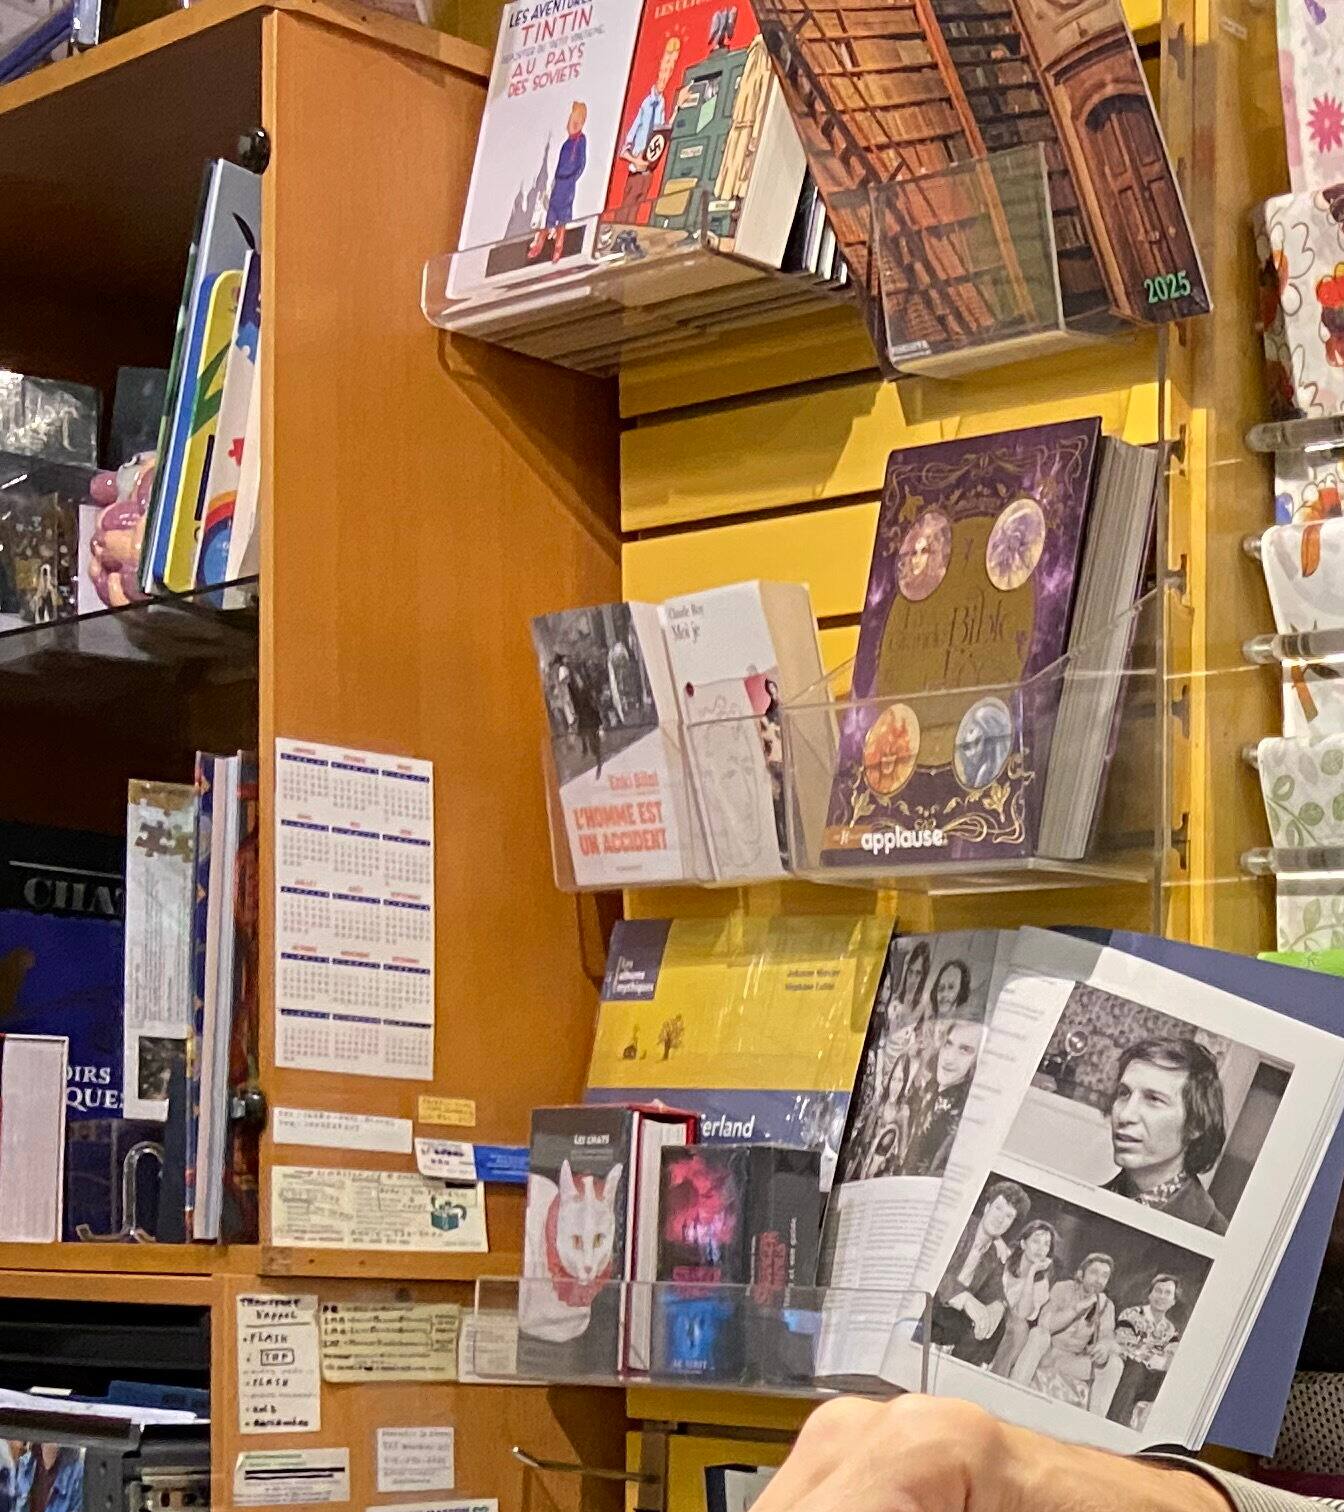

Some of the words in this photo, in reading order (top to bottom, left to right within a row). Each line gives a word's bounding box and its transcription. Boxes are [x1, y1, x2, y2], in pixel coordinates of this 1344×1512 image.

[509, 7, 530, 28] LES
[531, 0, 593, 21] AVENTU
[522, 5, 593, 46] TINTIN
[512, 58, 536, 79] AU
[545, 43, 585, 69] PAYS
[507, 79, 527, 98] DES
[532, 63, 581, 91] SOVIETS
[1144, 271, 1191, 304] 2025
[637, 800, 662, 824] EST
[603, 828, 667, 854] ACCIDENT
[66, 1087, 124, 1112] QUE
[701, 1114, 755, 1138] erland
